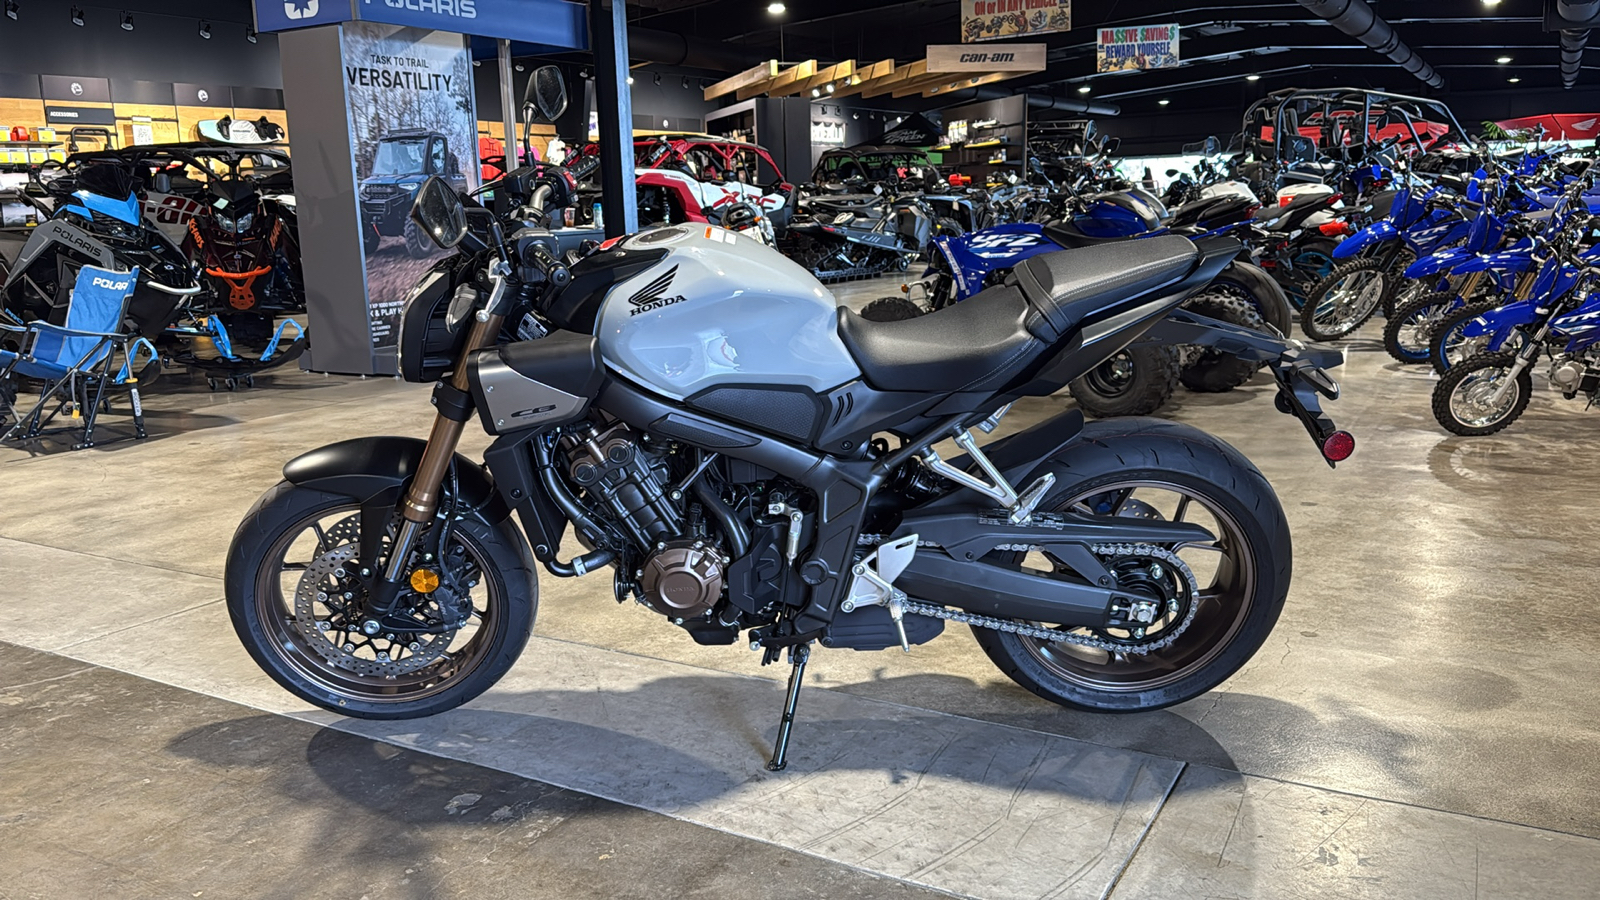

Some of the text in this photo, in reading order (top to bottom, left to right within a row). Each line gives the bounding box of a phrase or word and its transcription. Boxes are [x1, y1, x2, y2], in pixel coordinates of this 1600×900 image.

[365, 0, 477, 19] LARIS
[975, 1, 986, 16] ON
[960, 53, 1014, 63] can-am
[1106, 43, 1136, 59] REWARD
[1137, 41, 1171, 57] YOURSELF
[370, 54, 429, 69] TASK TO TRAIL
[346, 66, 452, 92] VERSATILITY
[53, 226, 103, 258] POLARIS
[381, 308, 397, 316] PLAY
[630, 295, 688, 317] HONDA
[666, 586, 696, 594] HONDA
